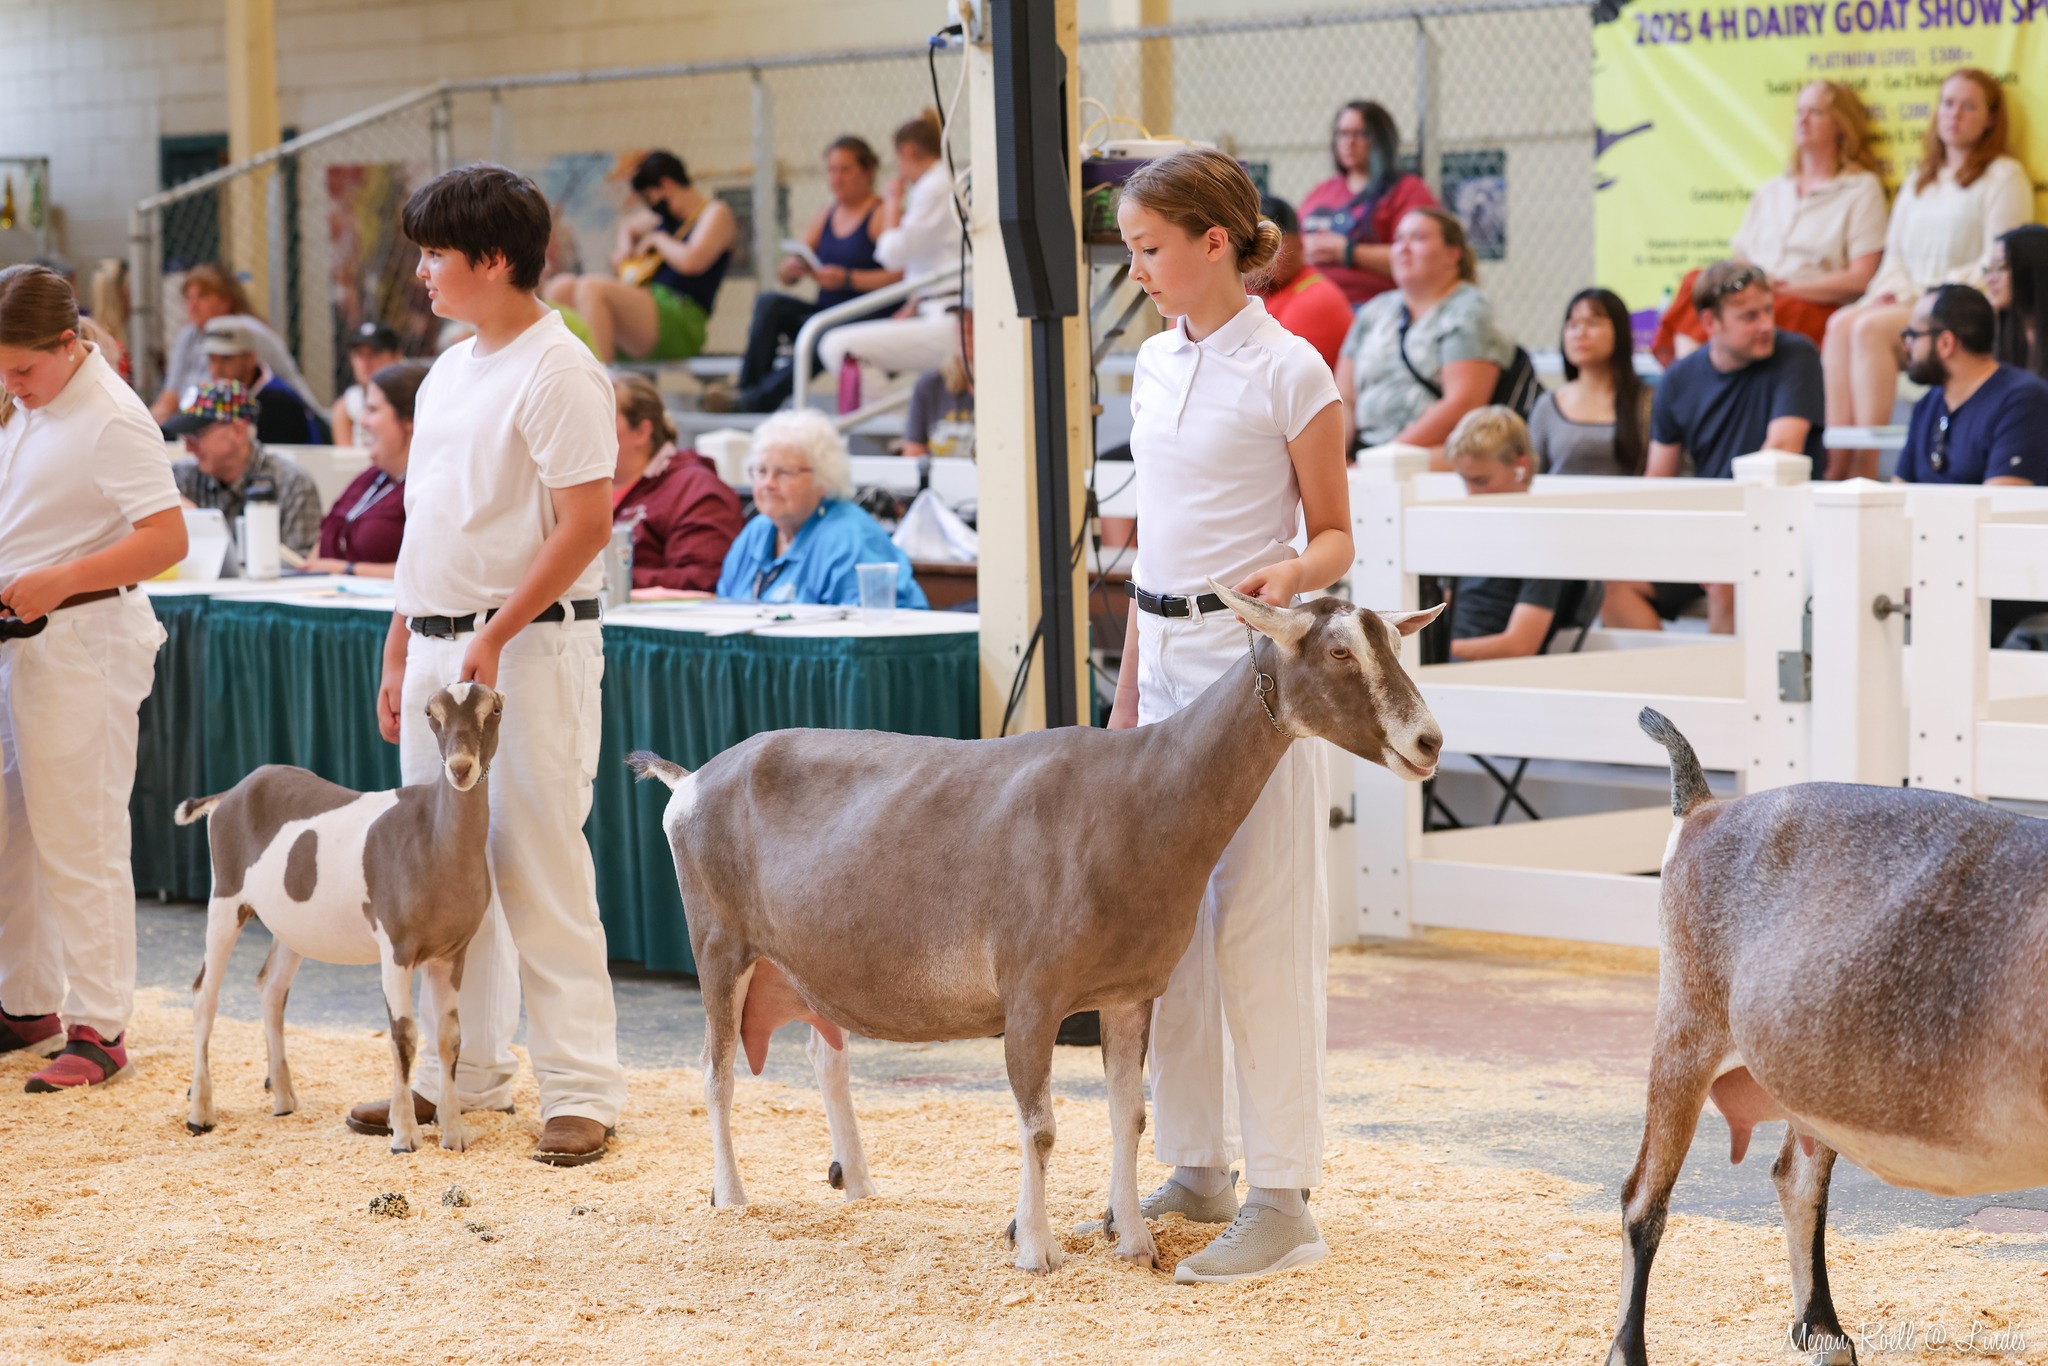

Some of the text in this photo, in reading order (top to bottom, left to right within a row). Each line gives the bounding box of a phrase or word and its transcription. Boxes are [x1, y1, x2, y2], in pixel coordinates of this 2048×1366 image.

[1634, 0, 2048, 45] 2025 4-H DAIRY GOAT SHOW SP
